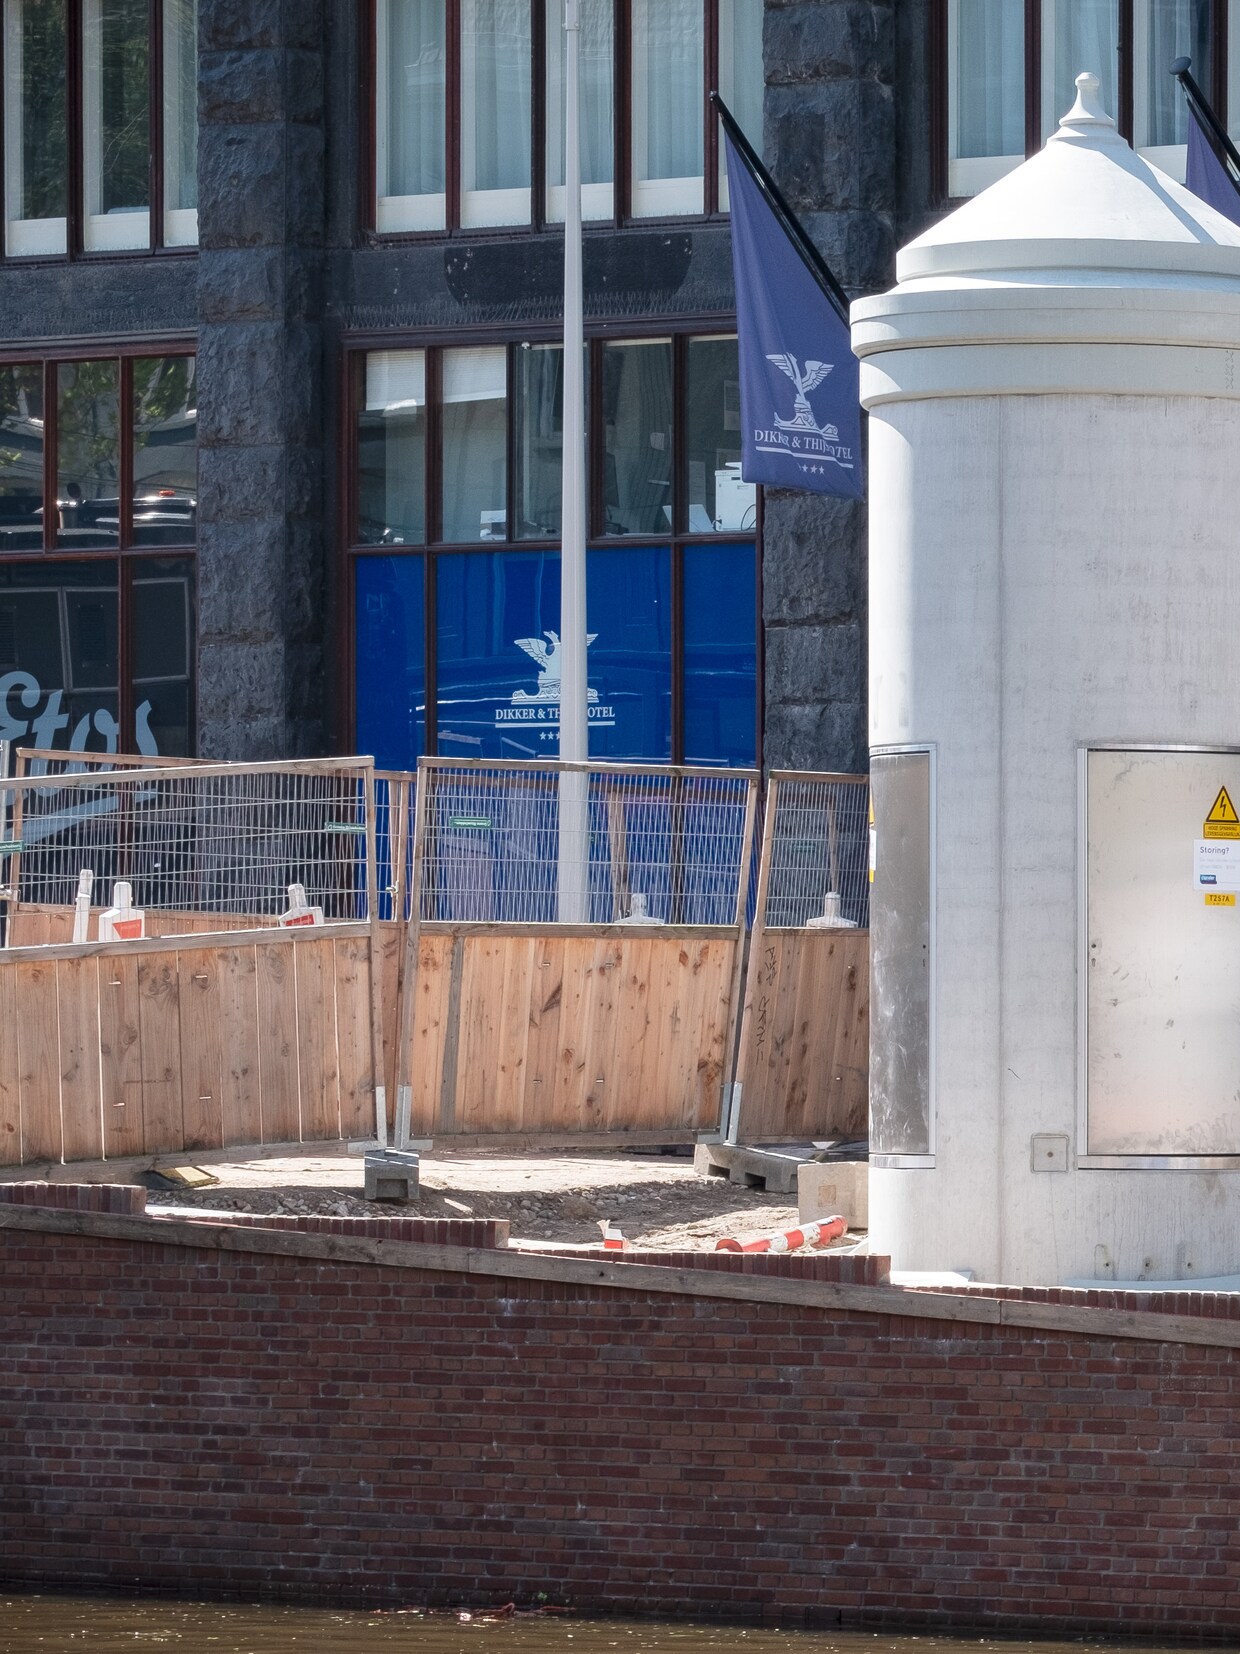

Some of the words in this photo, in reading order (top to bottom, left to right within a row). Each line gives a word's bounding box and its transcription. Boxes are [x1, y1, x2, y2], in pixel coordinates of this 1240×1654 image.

[791, 436, 801, 448] &
[495, 708, 536, 720] DIKKER
[537, 709, 546, 719] &
[587, 706, 615, 718] OTEL
[1200, 846, 1230, 856] Storing?
